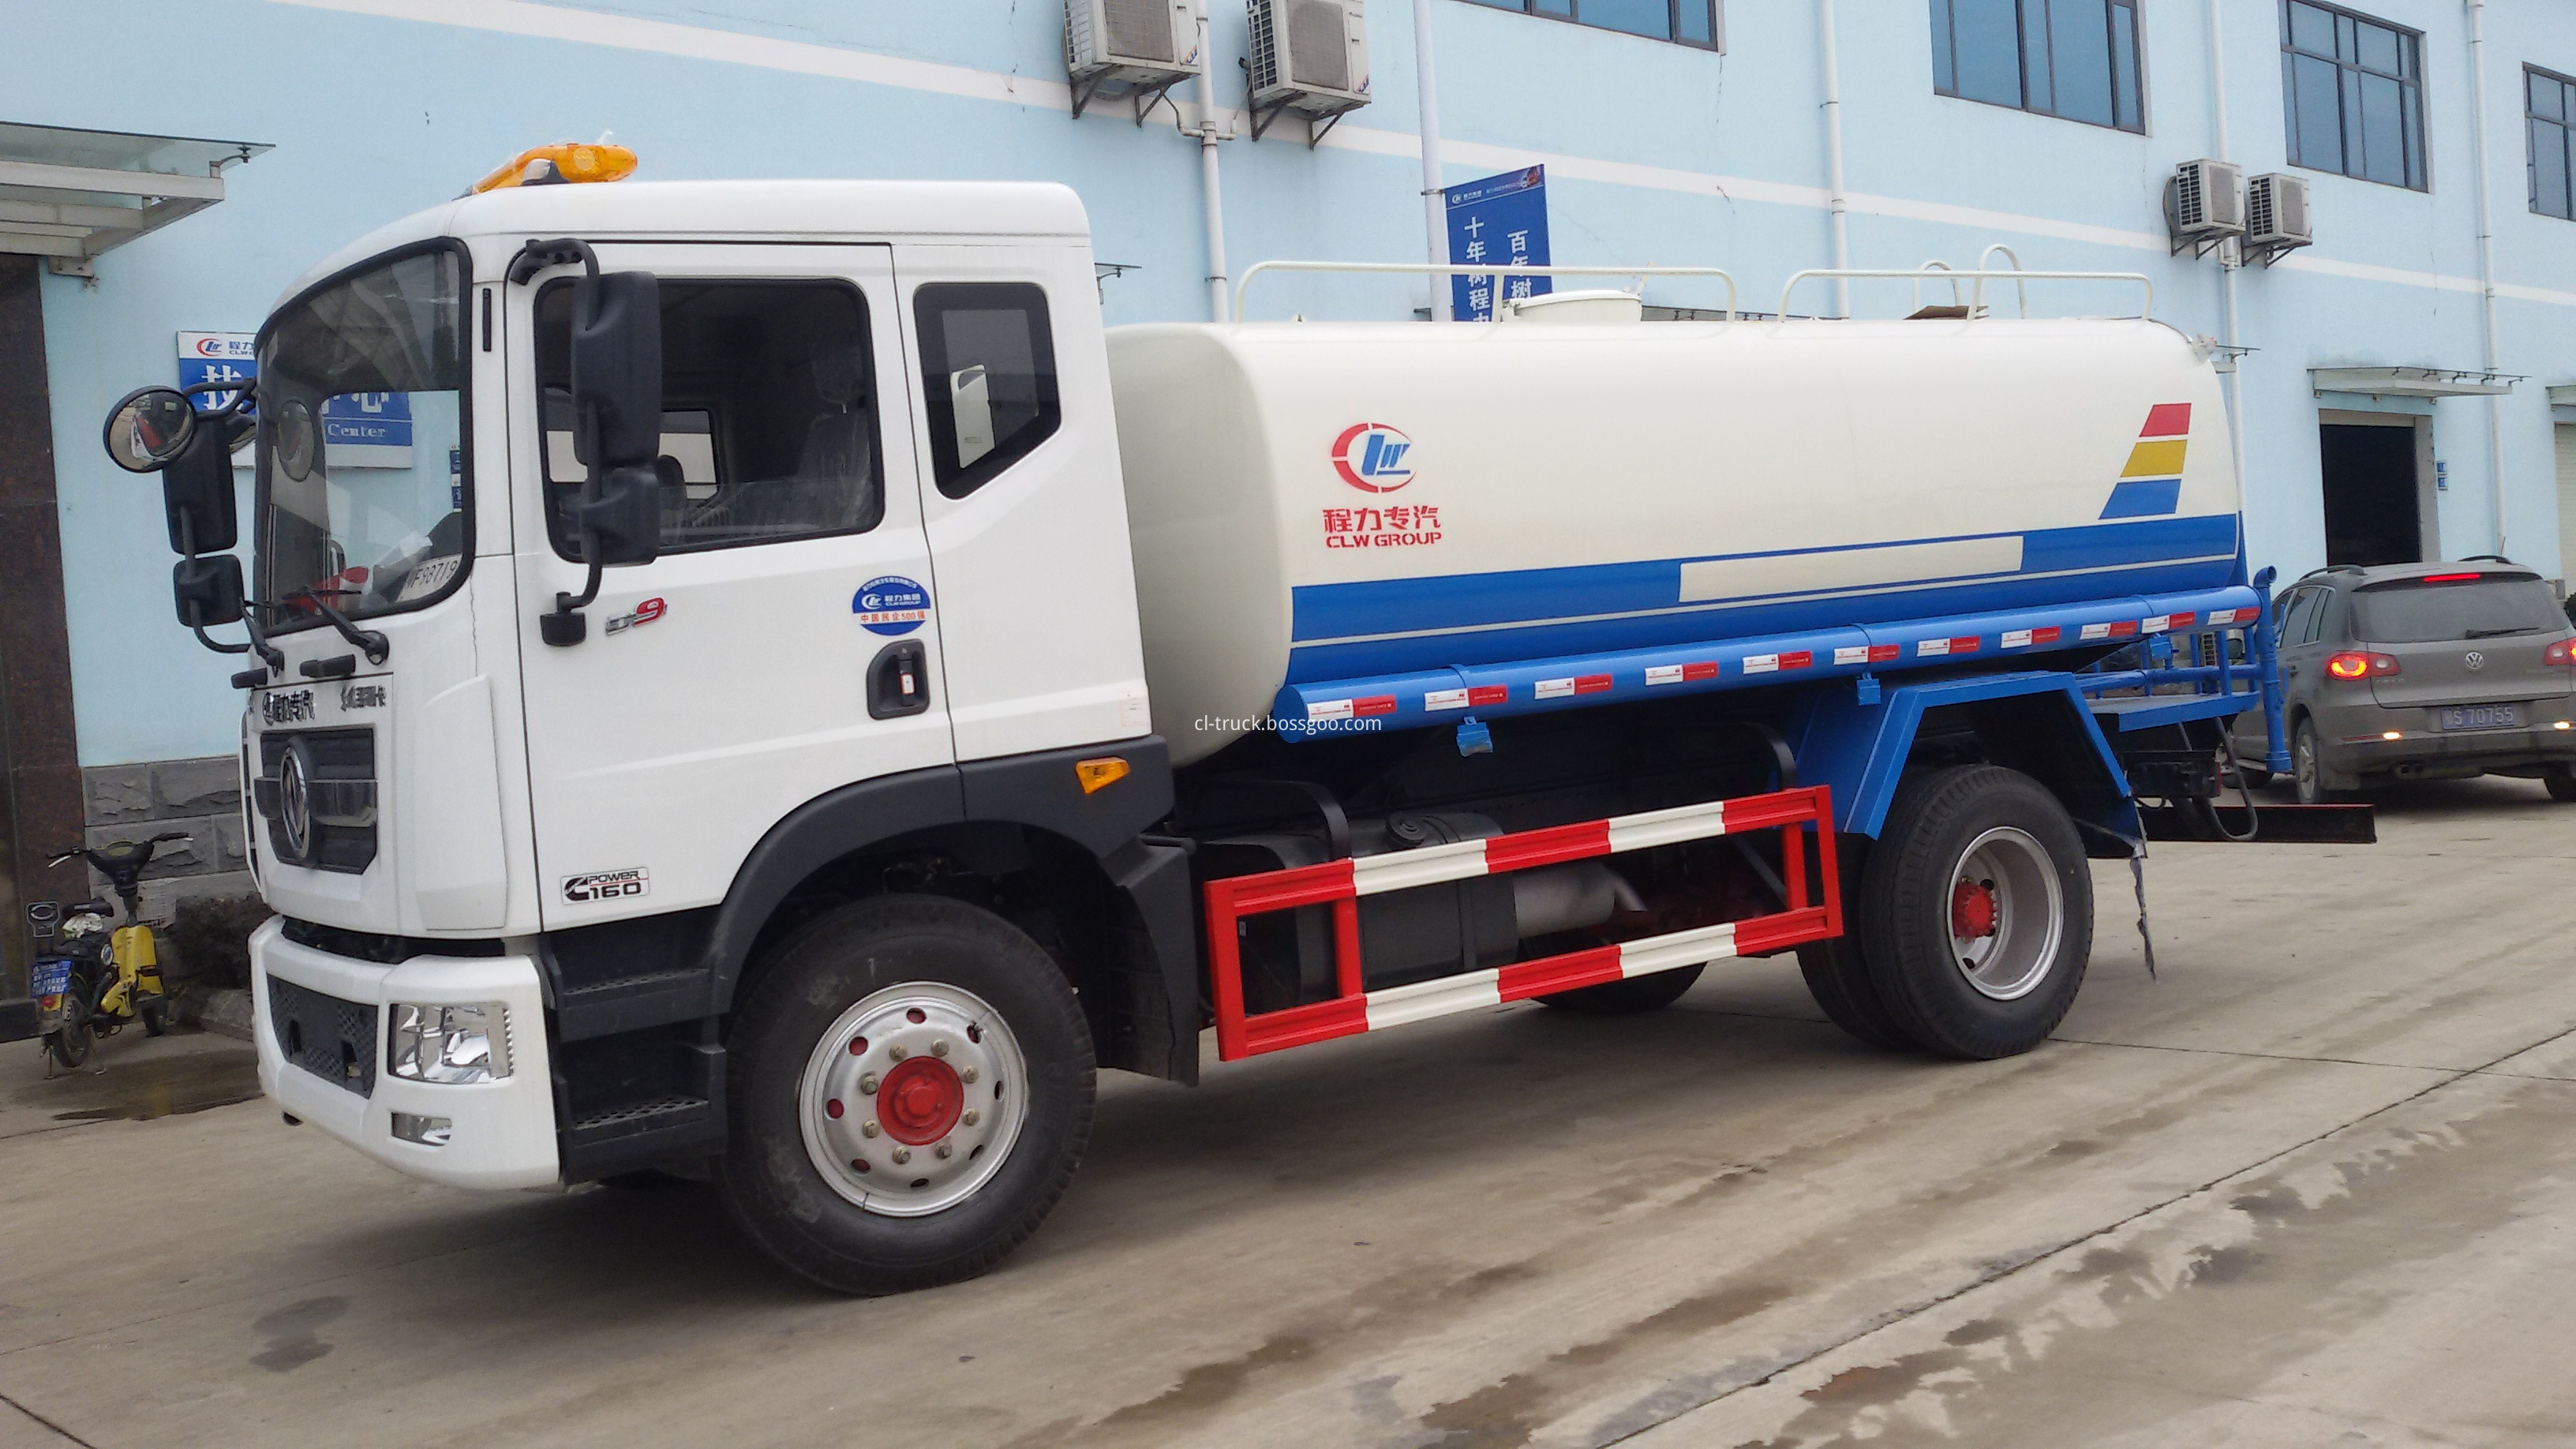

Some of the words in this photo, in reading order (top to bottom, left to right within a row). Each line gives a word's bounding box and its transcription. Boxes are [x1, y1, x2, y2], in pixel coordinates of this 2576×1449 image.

[328, 423, 386, 438] Center
[1323, 506, 1441, 533] 程力专汽
[1326, 534, 1369, 548] CLW
[1374, 532, 1442, 547] GROUP
[590, 882, 642, 900] 160
